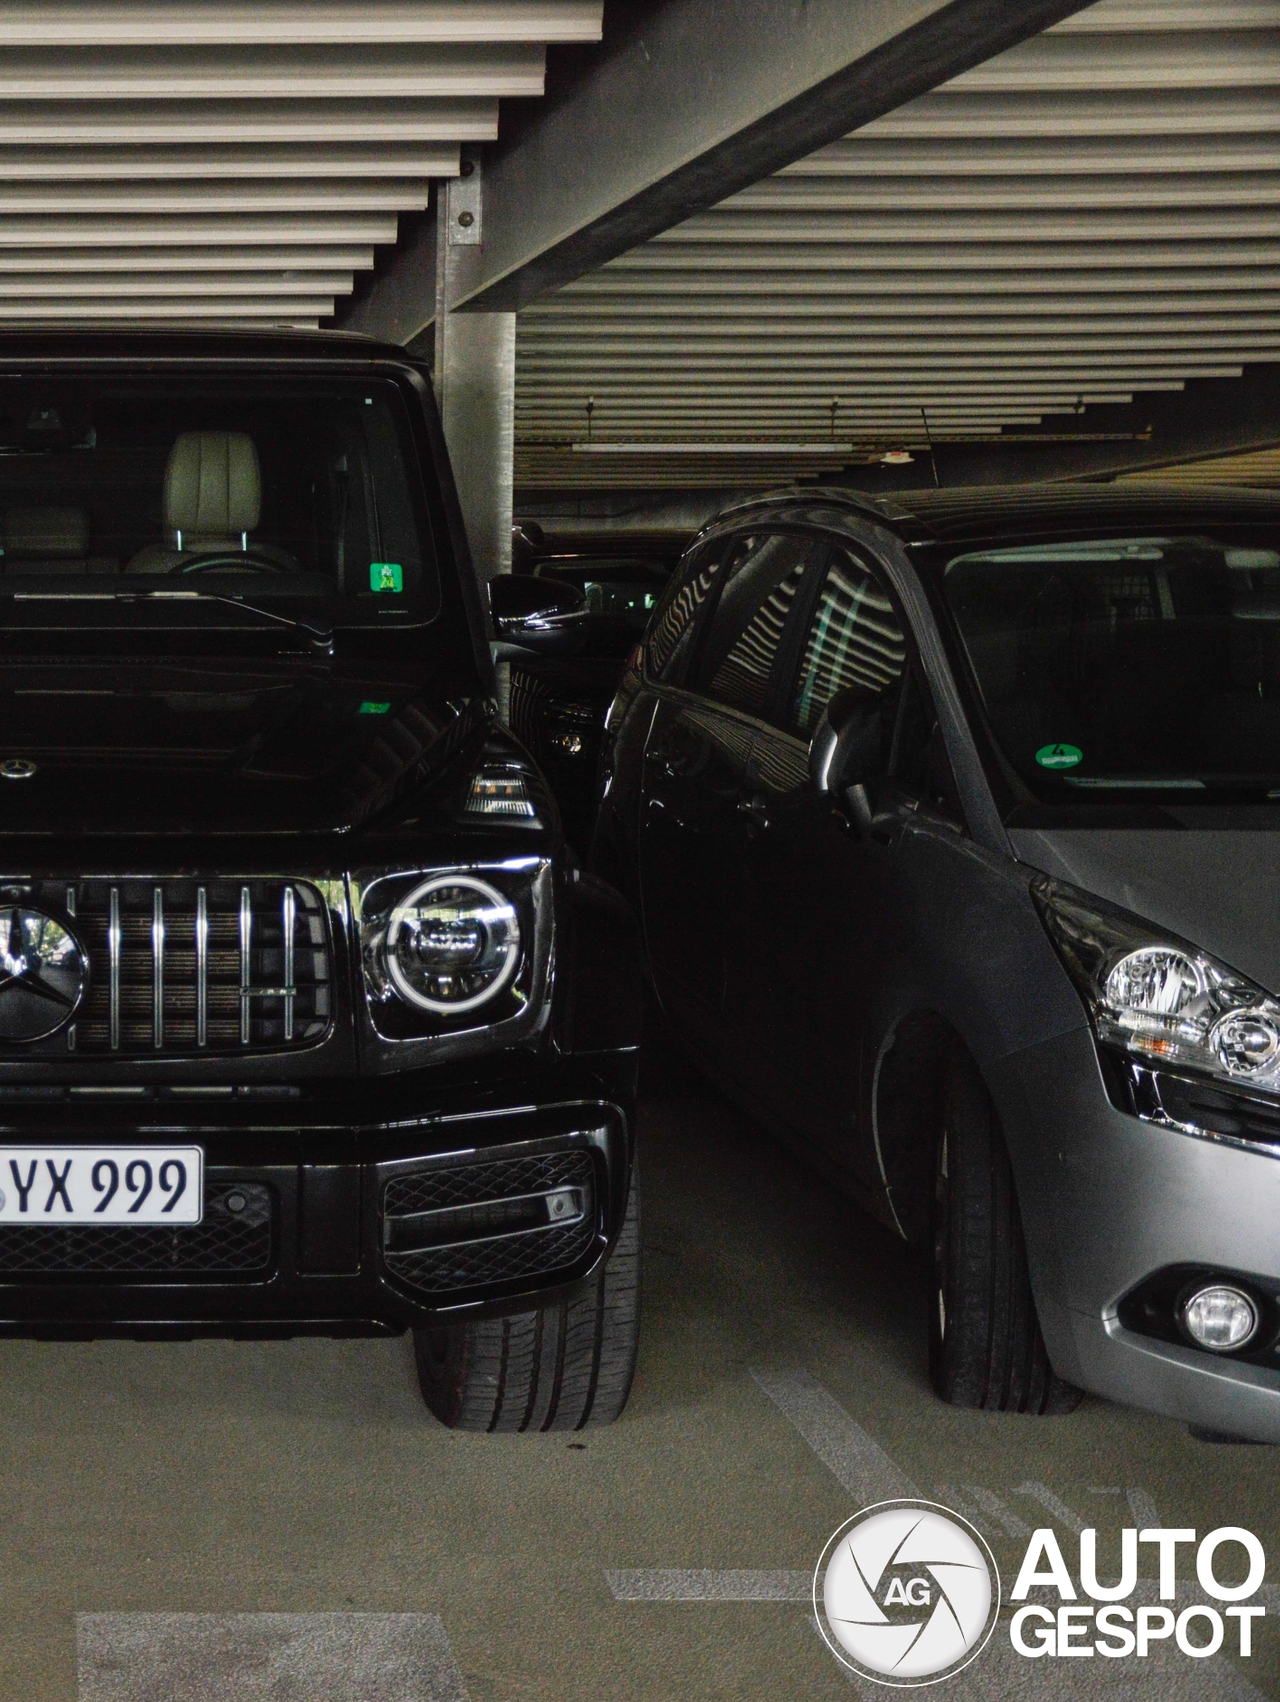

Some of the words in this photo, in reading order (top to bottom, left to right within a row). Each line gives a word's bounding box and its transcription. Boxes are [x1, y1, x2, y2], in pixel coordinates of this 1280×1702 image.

[1051, 744, 1066, 757] 4
[9, 1158, 74, 1213] YX
[91, 1158, 188, 1214] 999
